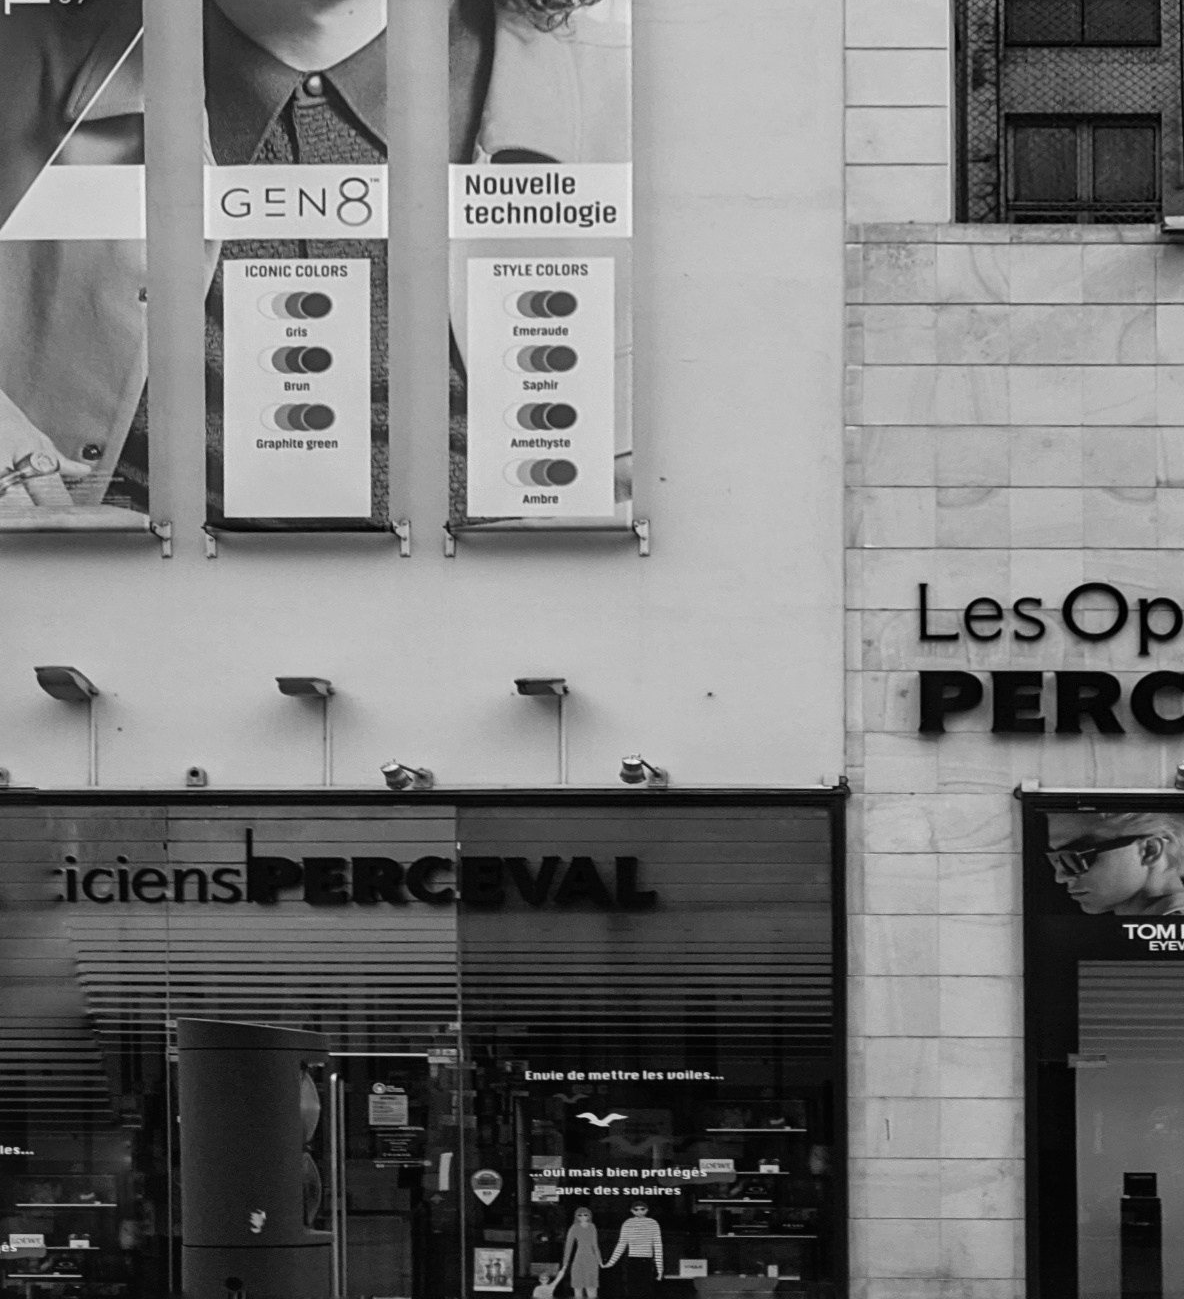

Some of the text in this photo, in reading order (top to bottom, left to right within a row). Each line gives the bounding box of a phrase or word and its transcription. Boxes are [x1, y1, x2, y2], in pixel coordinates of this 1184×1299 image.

[465, 172, 576, 196] Nouvelle
[220, 177, 373, 226] GEN8
[464, 201, 617, 228] technologie
[245, 264, 348, 278] ICONIC COLORS
[493, 263, 589, 277] STYLE COLORS
[285, 327, 308, 338] Gris
[512, 323, 569, 337] Émeraude
[283, 381, 311, 392] Brun
[522, 379, 559, 392] Saphir
[256, 438, 339, 451] Graphite green
[510, 438, 571, 450] Améthyste
[522, 494, 559, 504] Ambre
[918, 582, 1045, 643] Les
[246, 855, 657, 908] PERCEVAL
[1122, 923, 1176, 940] TOM
[524, 1070, 725, 1081] Envie de mettre les voiles...
[529, 1166, 708, 1179] ...oui mais bien protégés
[556, 1186, 682, 1196] avec des solaires
